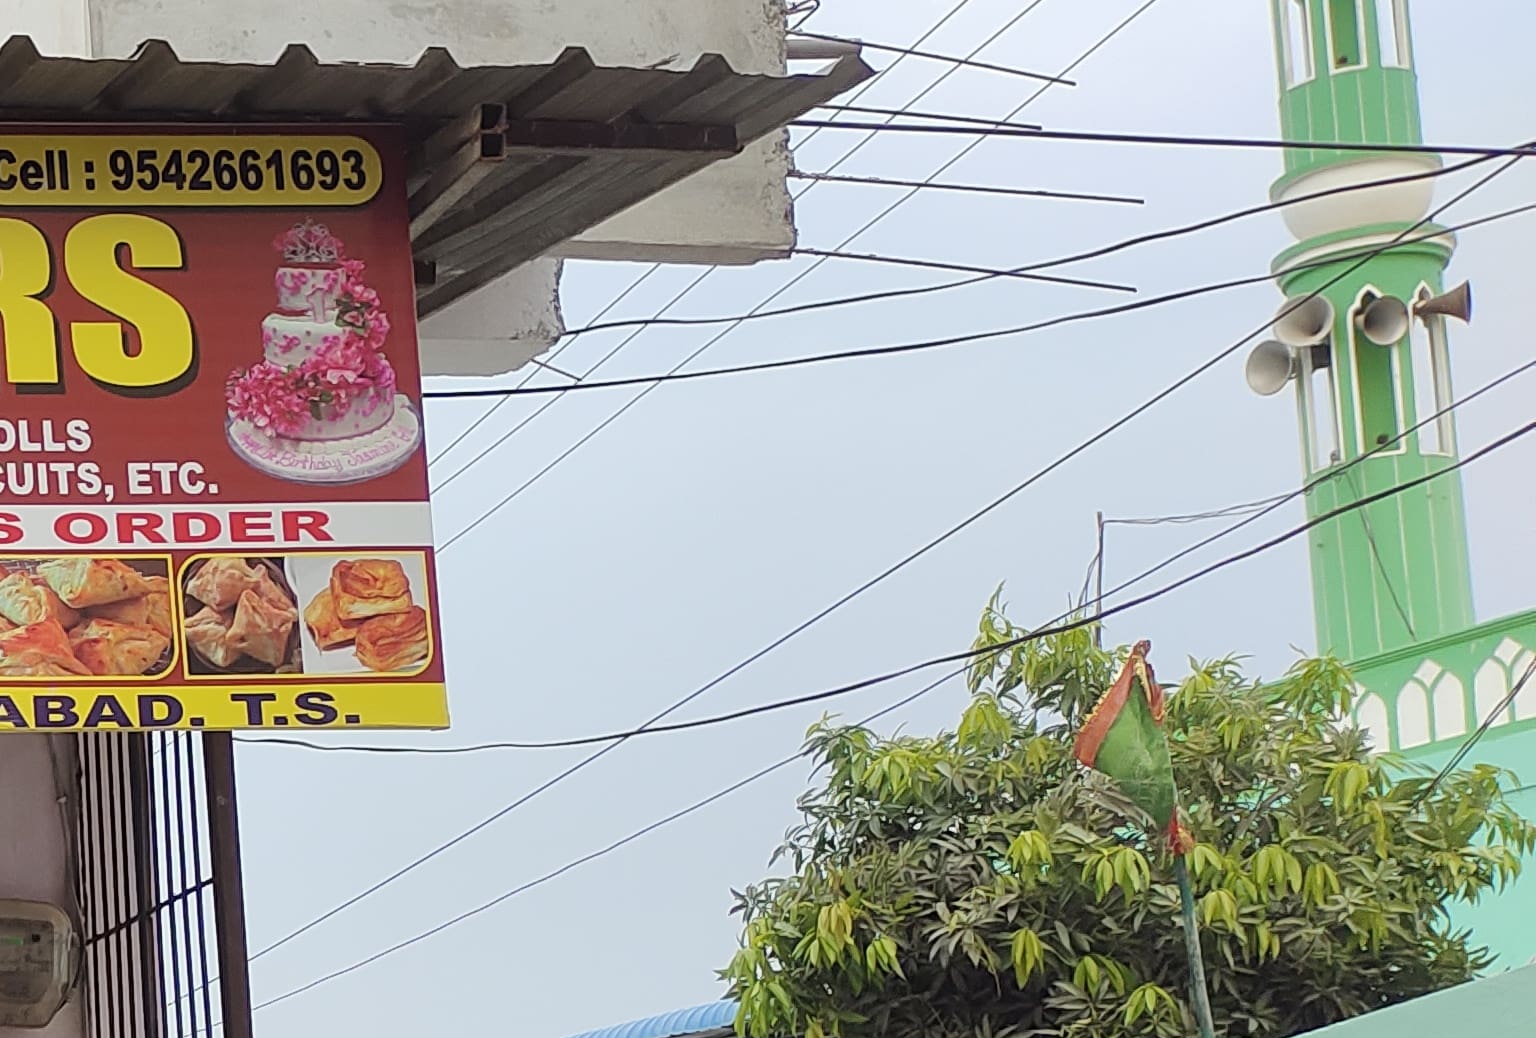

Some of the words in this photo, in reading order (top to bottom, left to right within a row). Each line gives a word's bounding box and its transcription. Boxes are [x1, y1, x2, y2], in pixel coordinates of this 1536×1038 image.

[84, 160, 96, 191] :
[108, 148, 367, 191] 9542661693
[127, 461, 219, 495] ETC.
[53, 511, 333, 545] ORDER
[230, 690, 361, 725] T.S.
